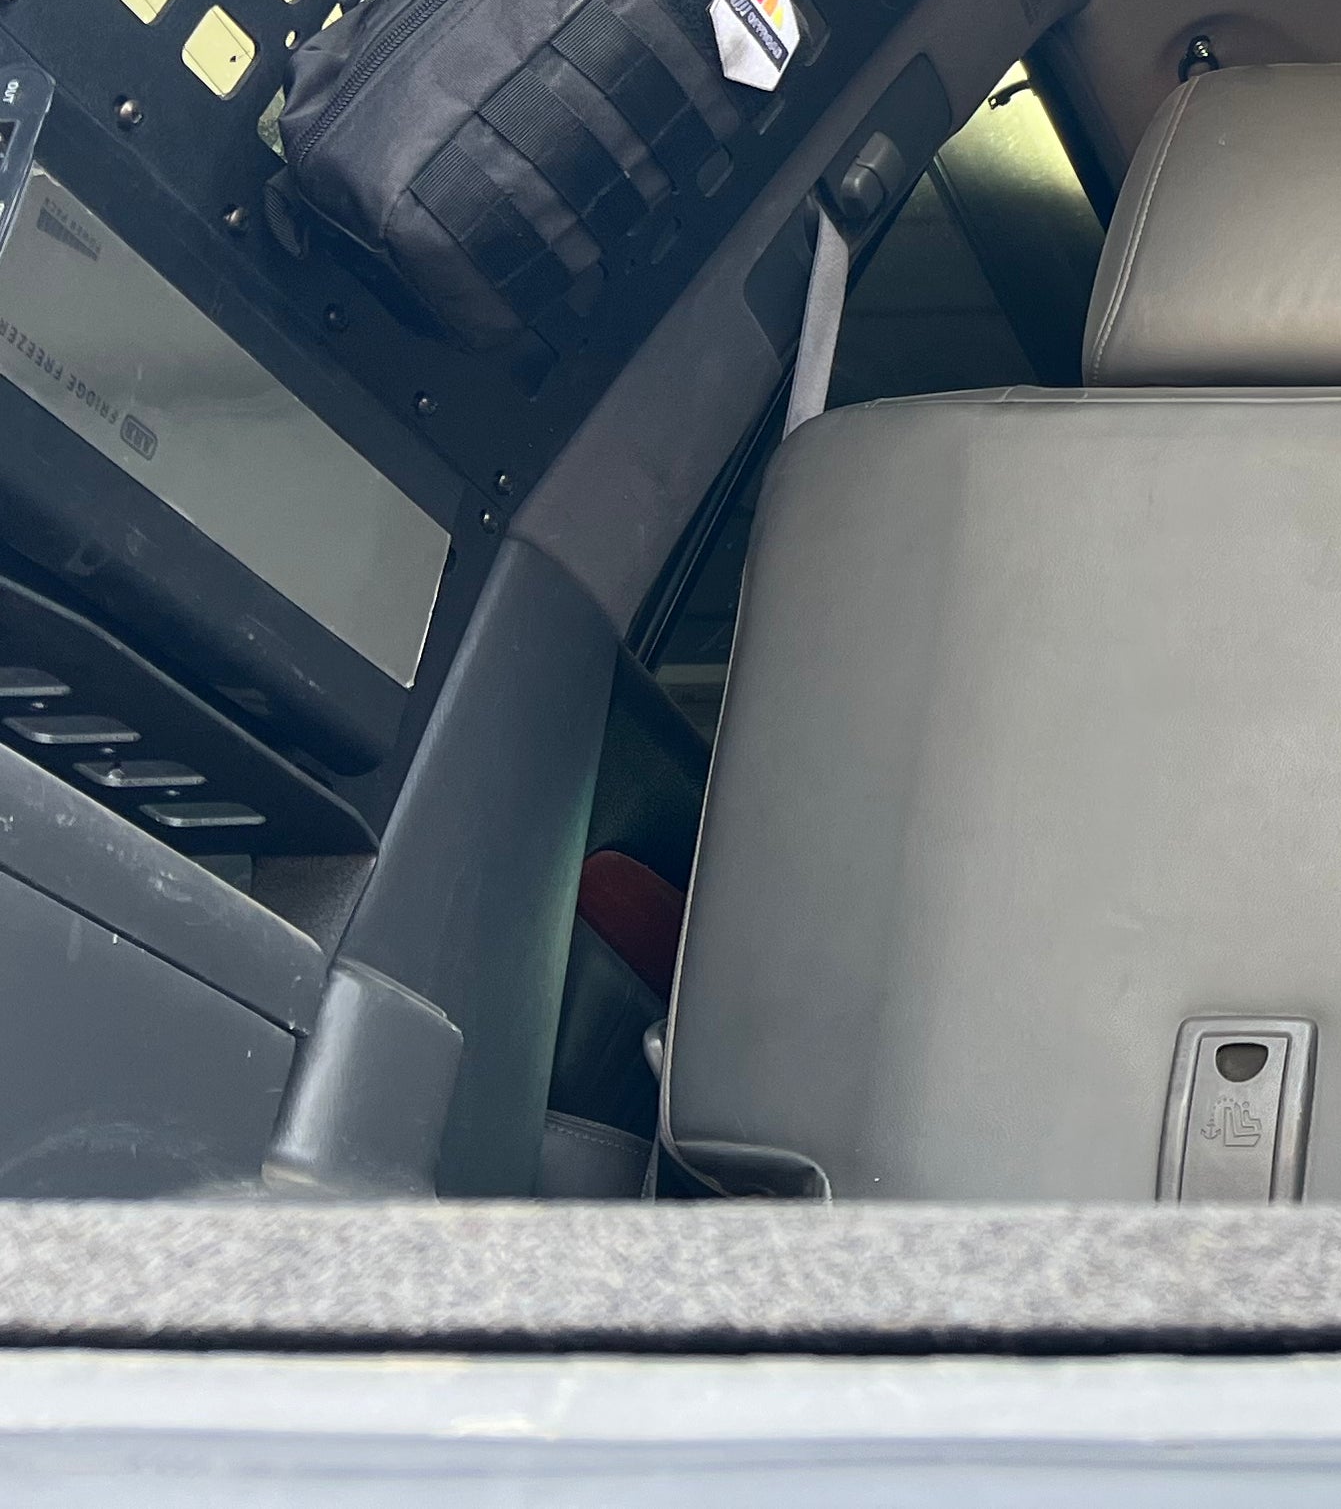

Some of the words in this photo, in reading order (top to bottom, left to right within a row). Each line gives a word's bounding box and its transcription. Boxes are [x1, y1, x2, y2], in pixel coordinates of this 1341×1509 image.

[3, 78, 20, 105] OUT
[0, 317, 63, 383] FREEZER
[67, 373, 119, 425] FRIDGE
